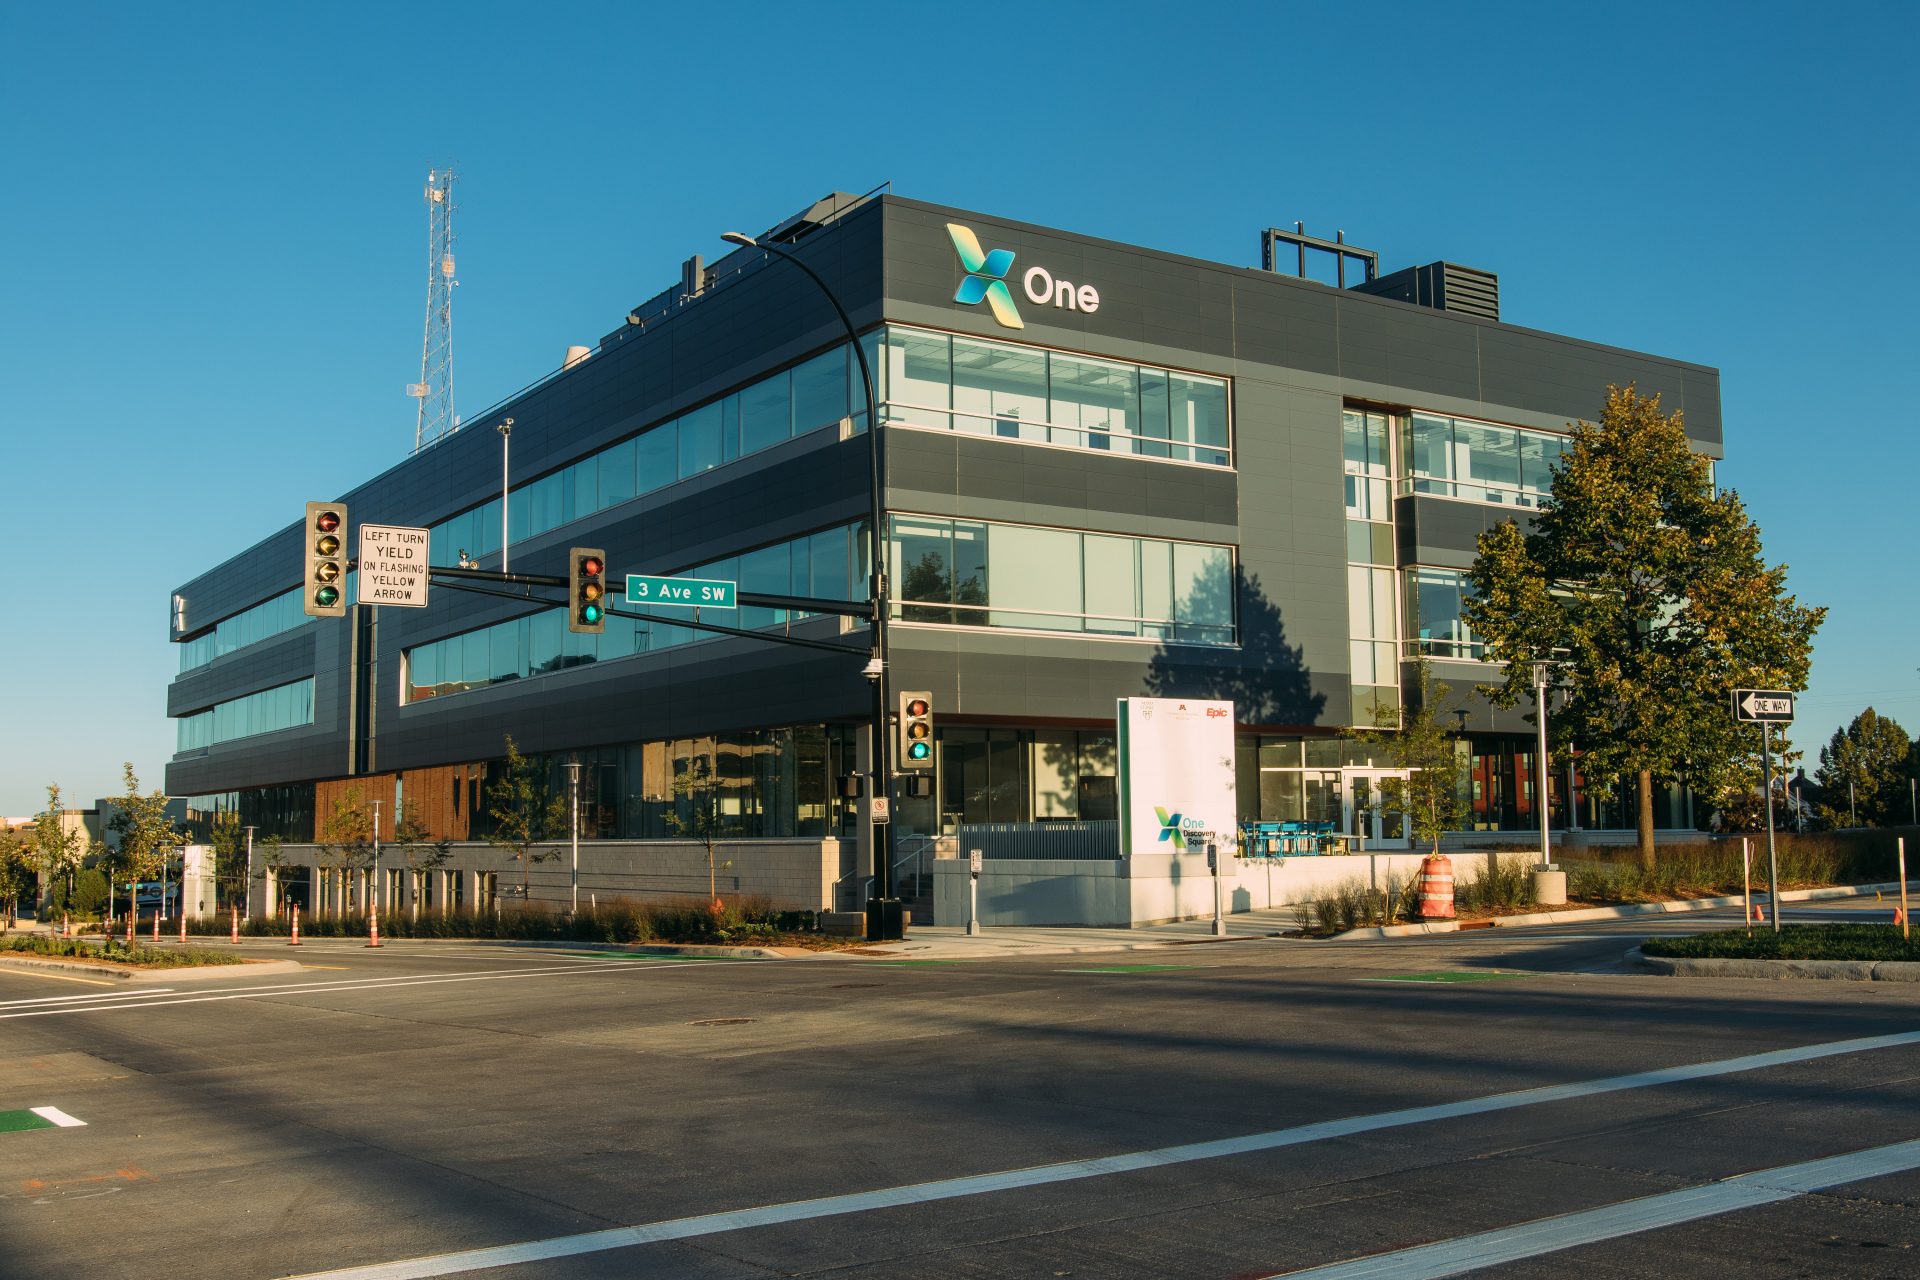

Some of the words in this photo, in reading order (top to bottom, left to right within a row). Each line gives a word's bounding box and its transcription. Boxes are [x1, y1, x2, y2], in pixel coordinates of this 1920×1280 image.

[1023, 266, 1100, 314] One
[365, 531, 391, 542] LEFT
[397, 534, 424, 544] TURN
[376, 546, 413, 559] YIELD
[363, 561, 376, 571] ON
[380, 562, 424, 574] FLASHING
[372, 575, 415, 587] YELLOW
[373, 588, 412, 600] ARROW
[638, 582, 649, 597] 3
[658, 584, 692, 599] Ave
[701, 586, 726, 601] SW
[1754, 700, 1769, 712] ONE
[1772, 701, 1787, 712] WAY
[1207, 708, 1228, 718] Epic
[1183, 818, 1204, 828] One
[1183, 830, 1216, 838] Discovery
[1188, 838, 1212, 847] Square
